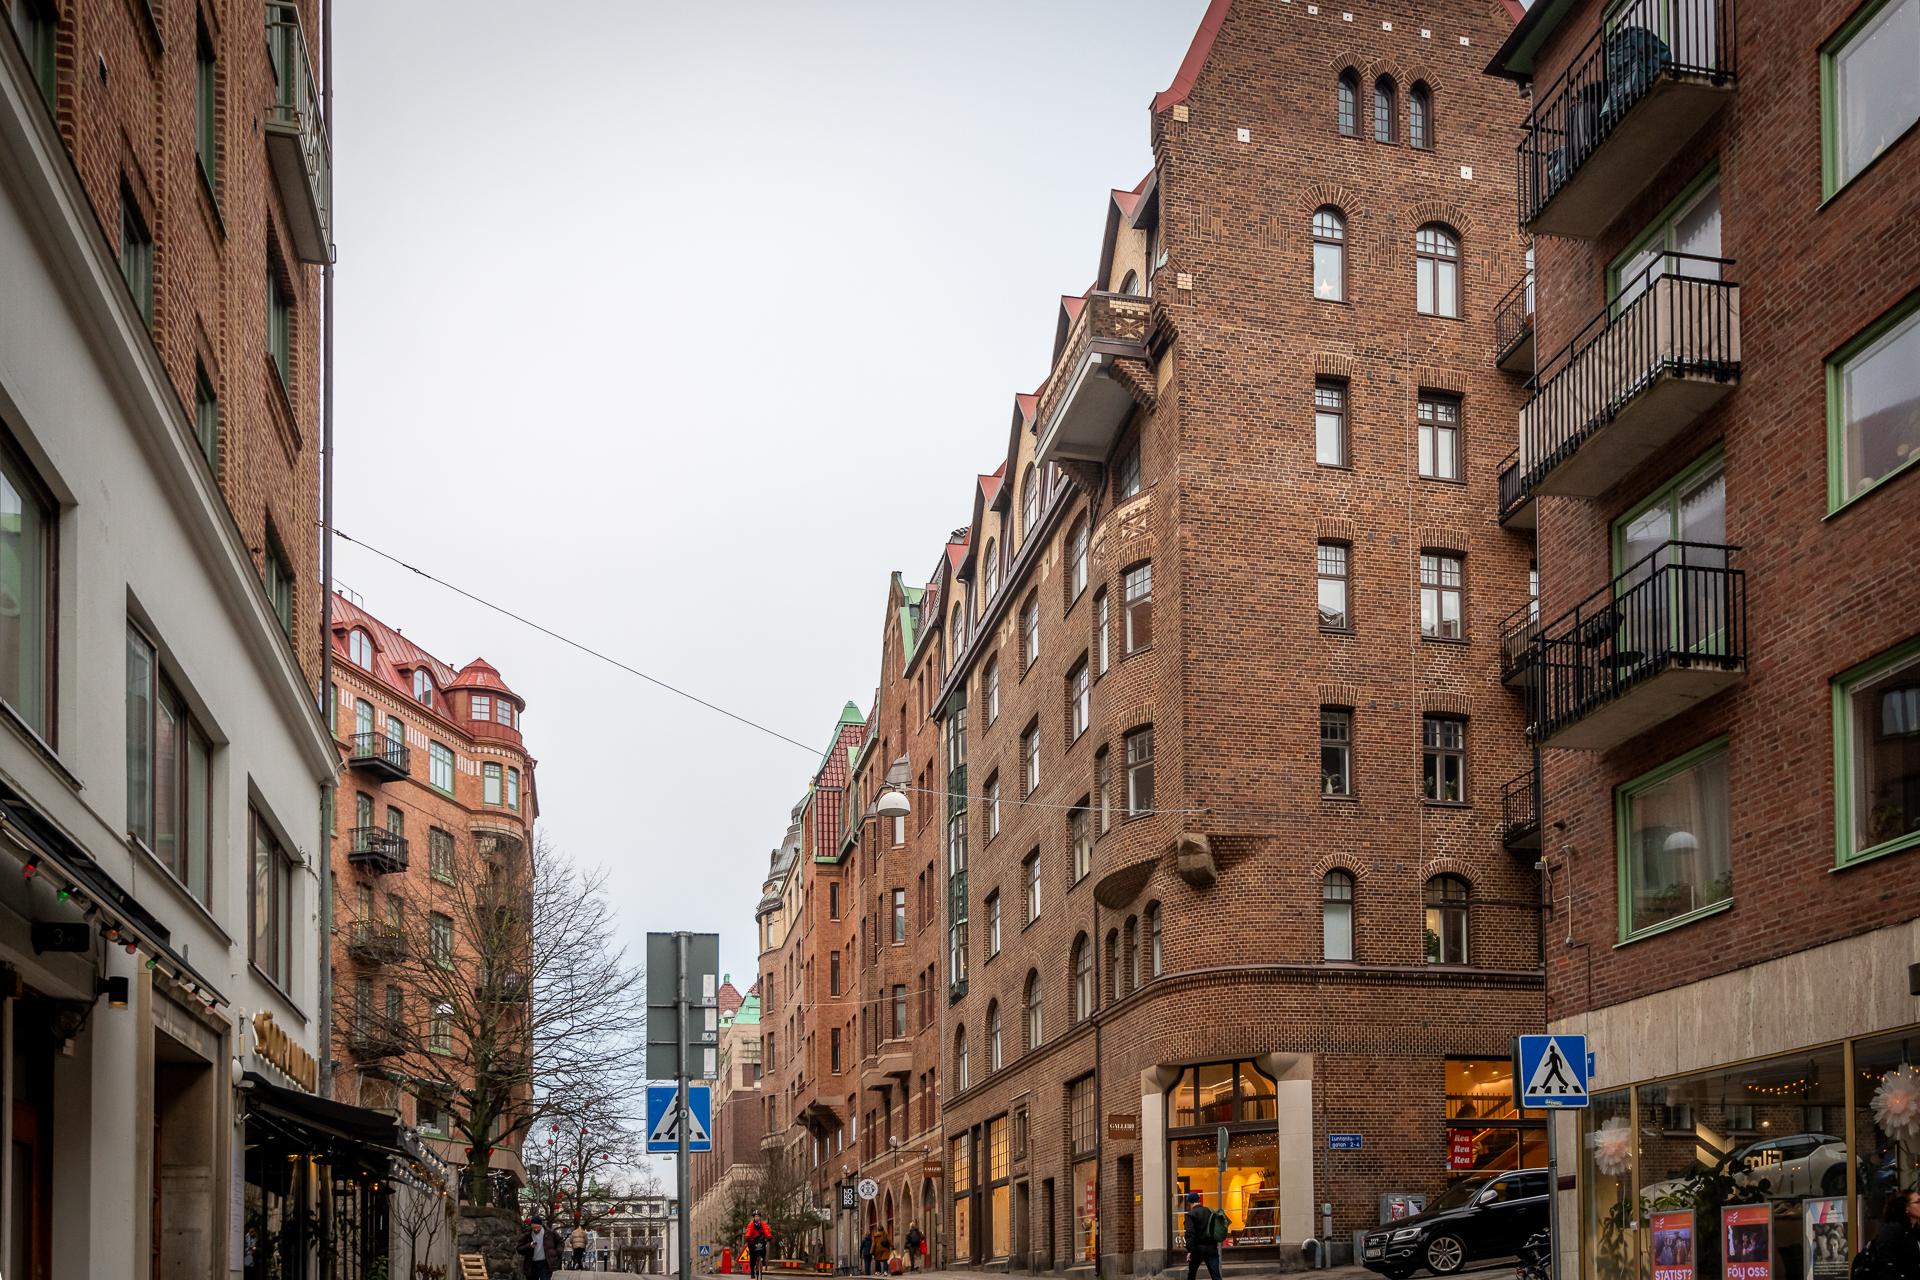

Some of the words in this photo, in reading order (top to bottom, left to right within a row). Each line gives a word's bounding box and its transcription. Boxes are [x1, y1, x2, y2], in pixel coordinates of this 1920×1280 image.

[1454, 1134, 1470, 1142] Rea
[1454, 1145, 1470, 1153] Rea
[1454, 1156, 1470, 1164] Rea
[1654, 1269, 1693, 1280] STATIST?
[1727, 1264, 1746, 1280] FÖLJ
[1747, 1266, 1769, 1277] OSS:
